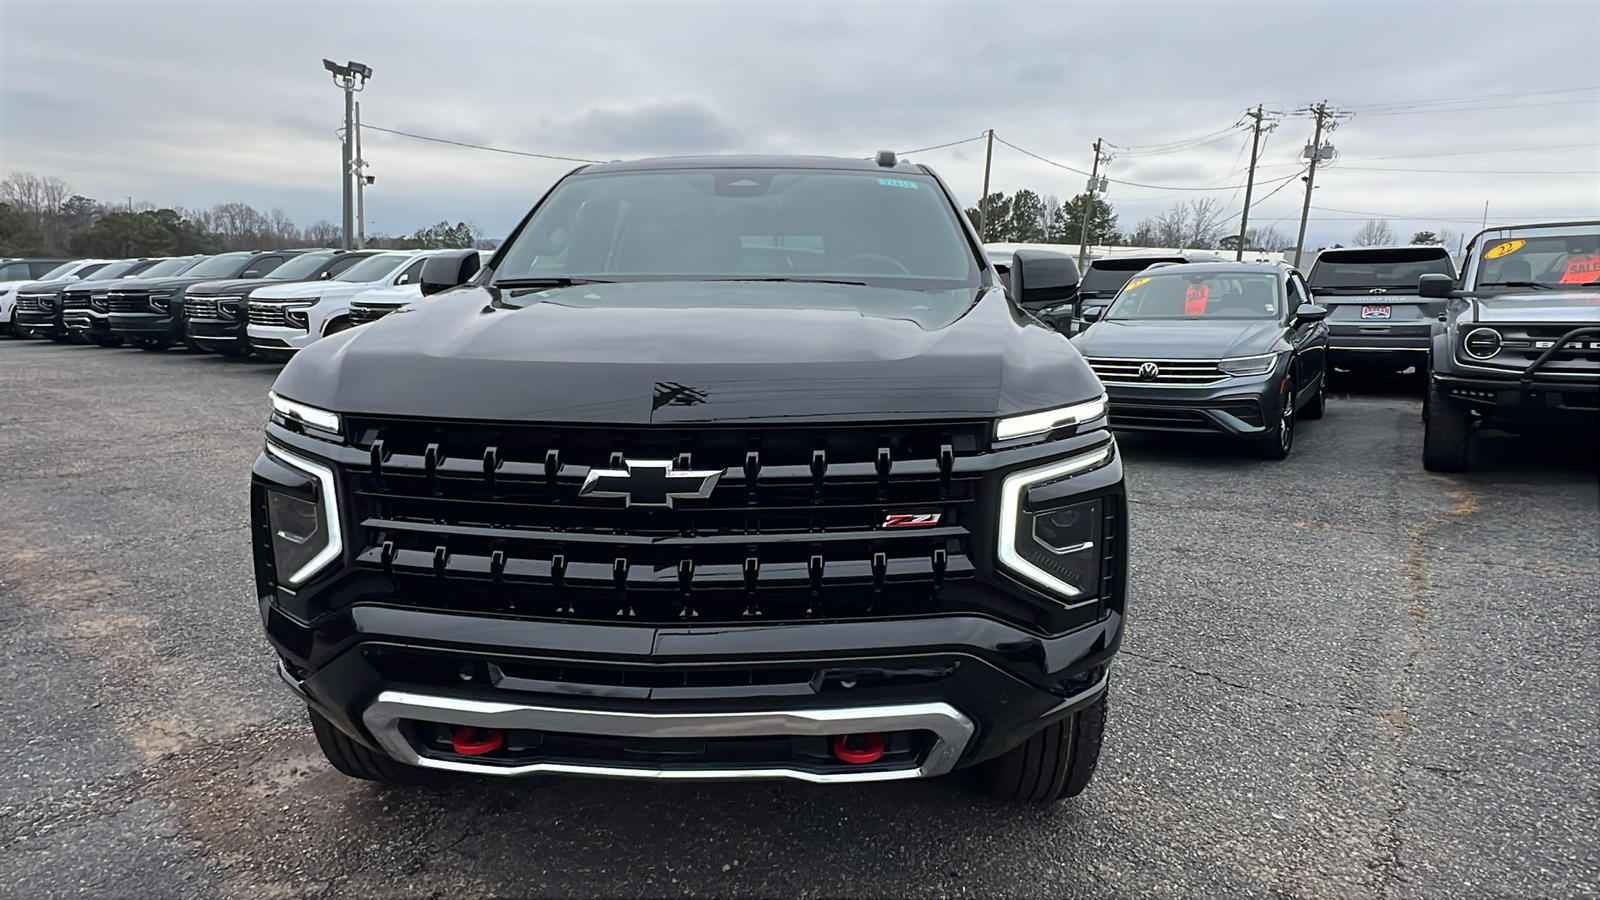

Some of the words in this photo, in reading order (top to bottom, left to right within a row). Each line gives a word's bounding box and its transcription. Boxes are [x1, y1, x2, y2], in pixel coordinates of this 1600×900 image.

[1499, 242, 1513, 255] 22
[1570, 262, 1600, 274] SALE
[1188, 289, 1206, 302] SALE
